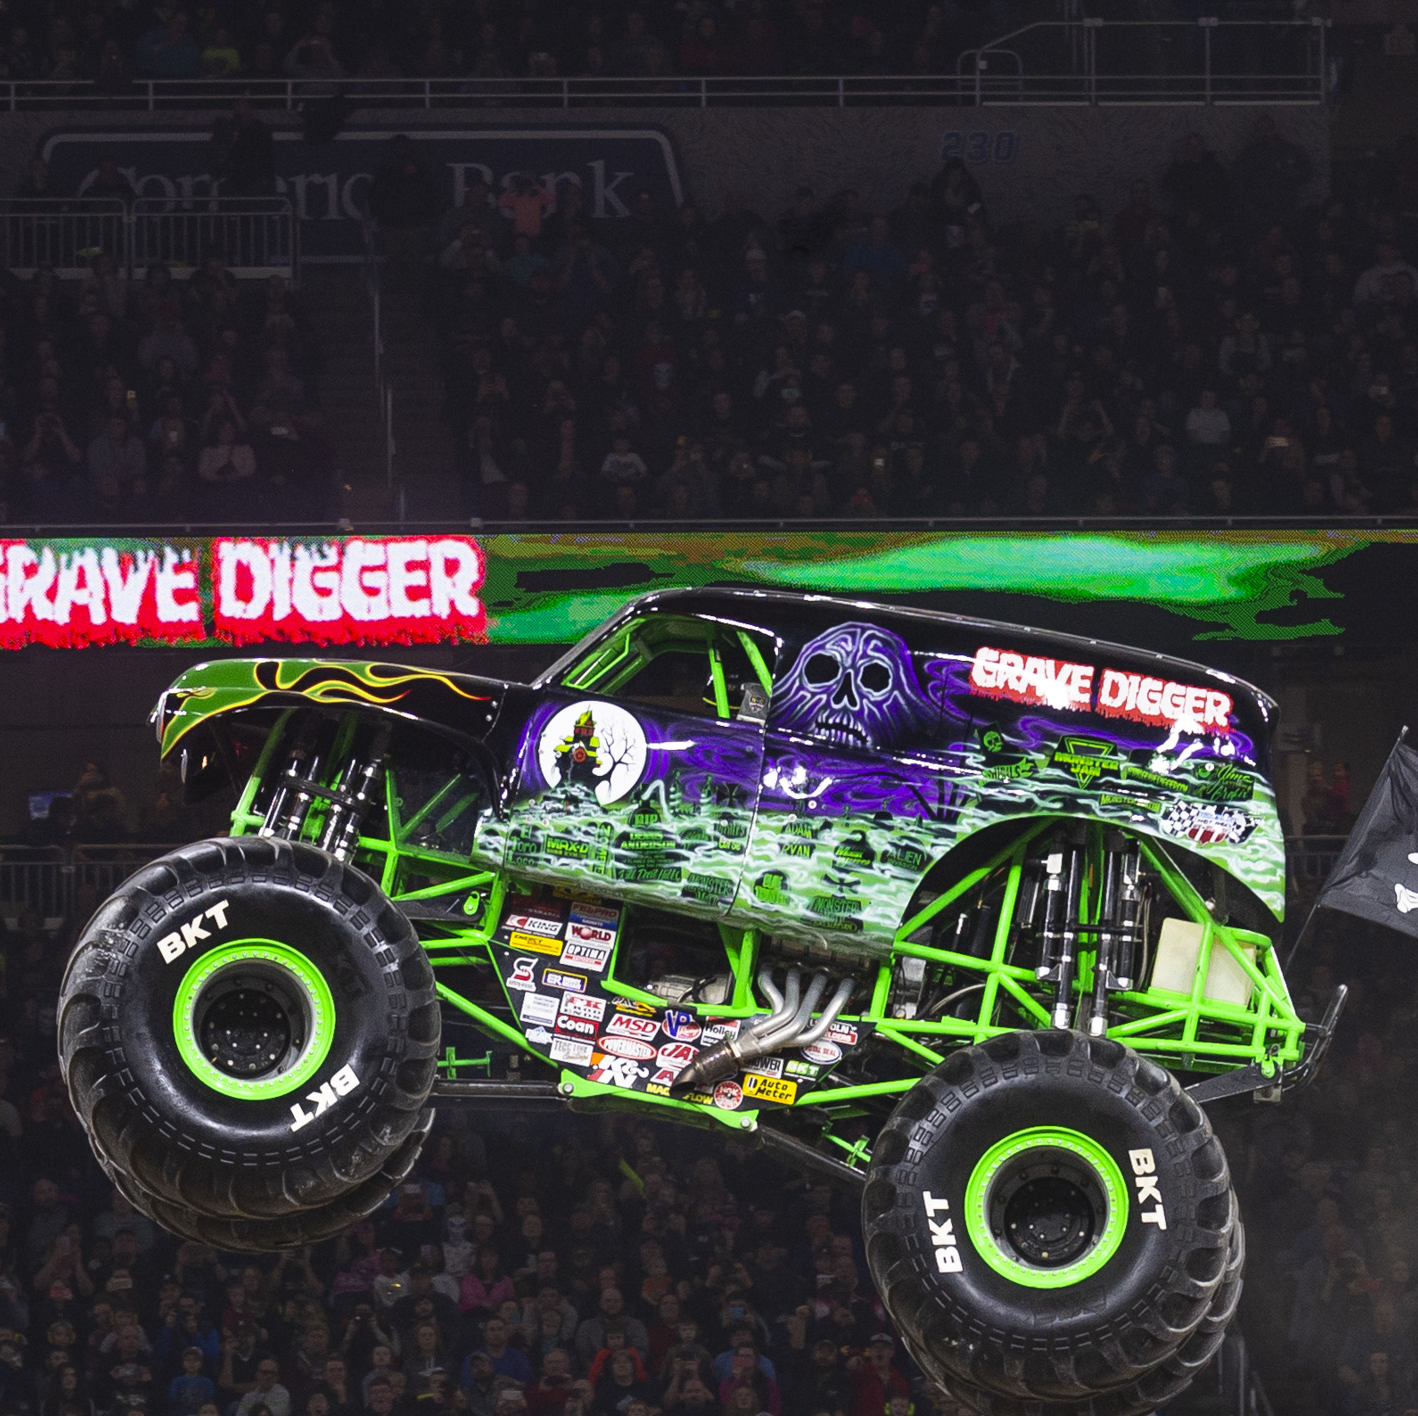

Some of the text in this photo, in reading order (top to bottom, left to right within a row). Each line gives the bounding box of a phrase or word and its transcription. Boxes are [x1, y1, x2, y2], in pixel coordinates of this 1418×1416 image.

[942, 132, 1015, 162] 230
[217, 539, 481, 622] DIGGER
[970, 647, 1233, 730] GRAVE DIGGER
[1054, 751, 1120, 770] MONSTER
[1070, 764, 1101, 778] JAM
[634, 812, 659, 825] RIP
[785, 823, 813, 839] ADAM
[510, 836, 537, 854] Toro
[781, 843, 811, 859] RYAN
[156, 899, 231, 965] BKT
[528, 918, 560, 933] KING
[572, 925, 612, 942] WORLD
[566, 944, 607, 960] OPTIMA
[556, 1014, 595, 1035] Coan
[612, 1016, 657, 1034] MSD
[664, 1010, 692, 1037] VP
[785, 1059, 820, 1076] BKT
[754, 1086, 793, 1100] Meter
[760, 1079, 789, 1091] Auto
[288, 1062, 362, 1133] BKT
[1127, 1147, 1168, 1231] BKT
[922, 1190, 965, 1275] BKT
